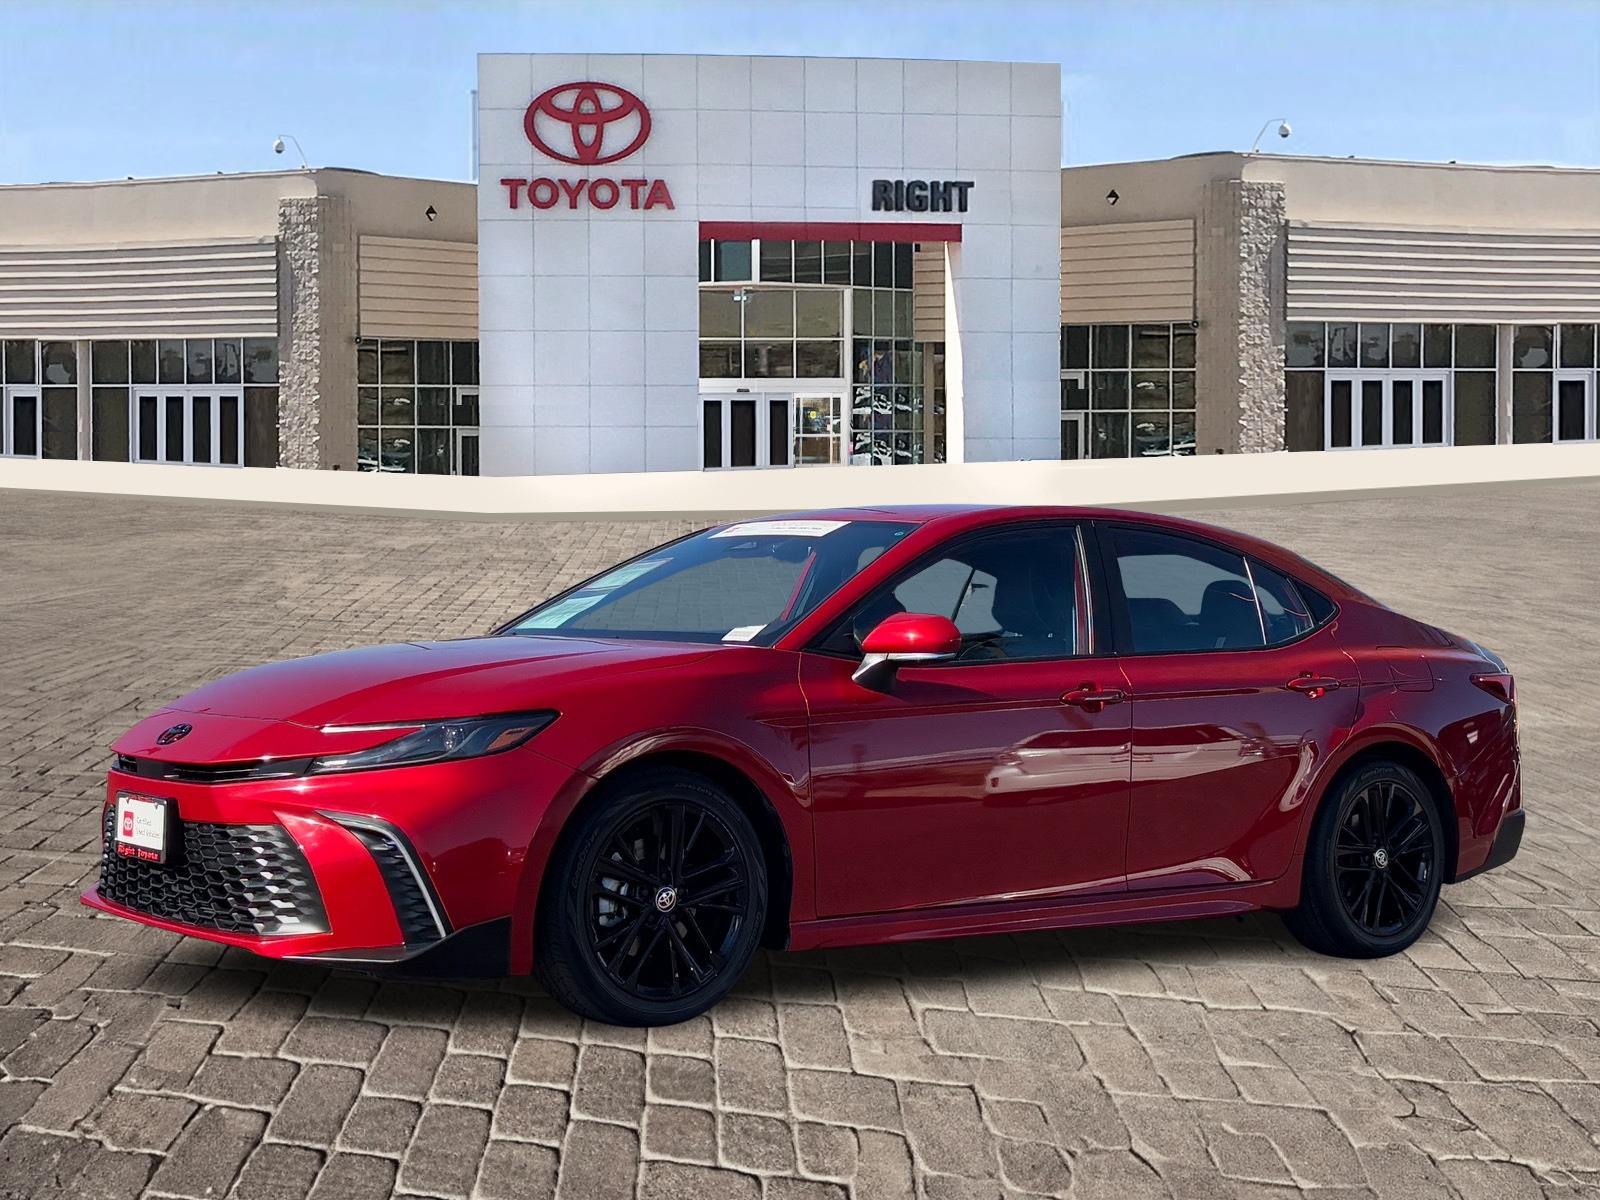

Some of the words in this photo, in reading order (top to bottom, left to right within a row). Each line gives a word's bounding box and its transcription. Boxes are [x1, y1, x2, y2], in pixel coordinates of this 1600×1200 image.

[500, 178, 676, 210] TOYOTA
[871, 179, 975, 213] RIGHT
[138, 849, 158, 860] Toyota
